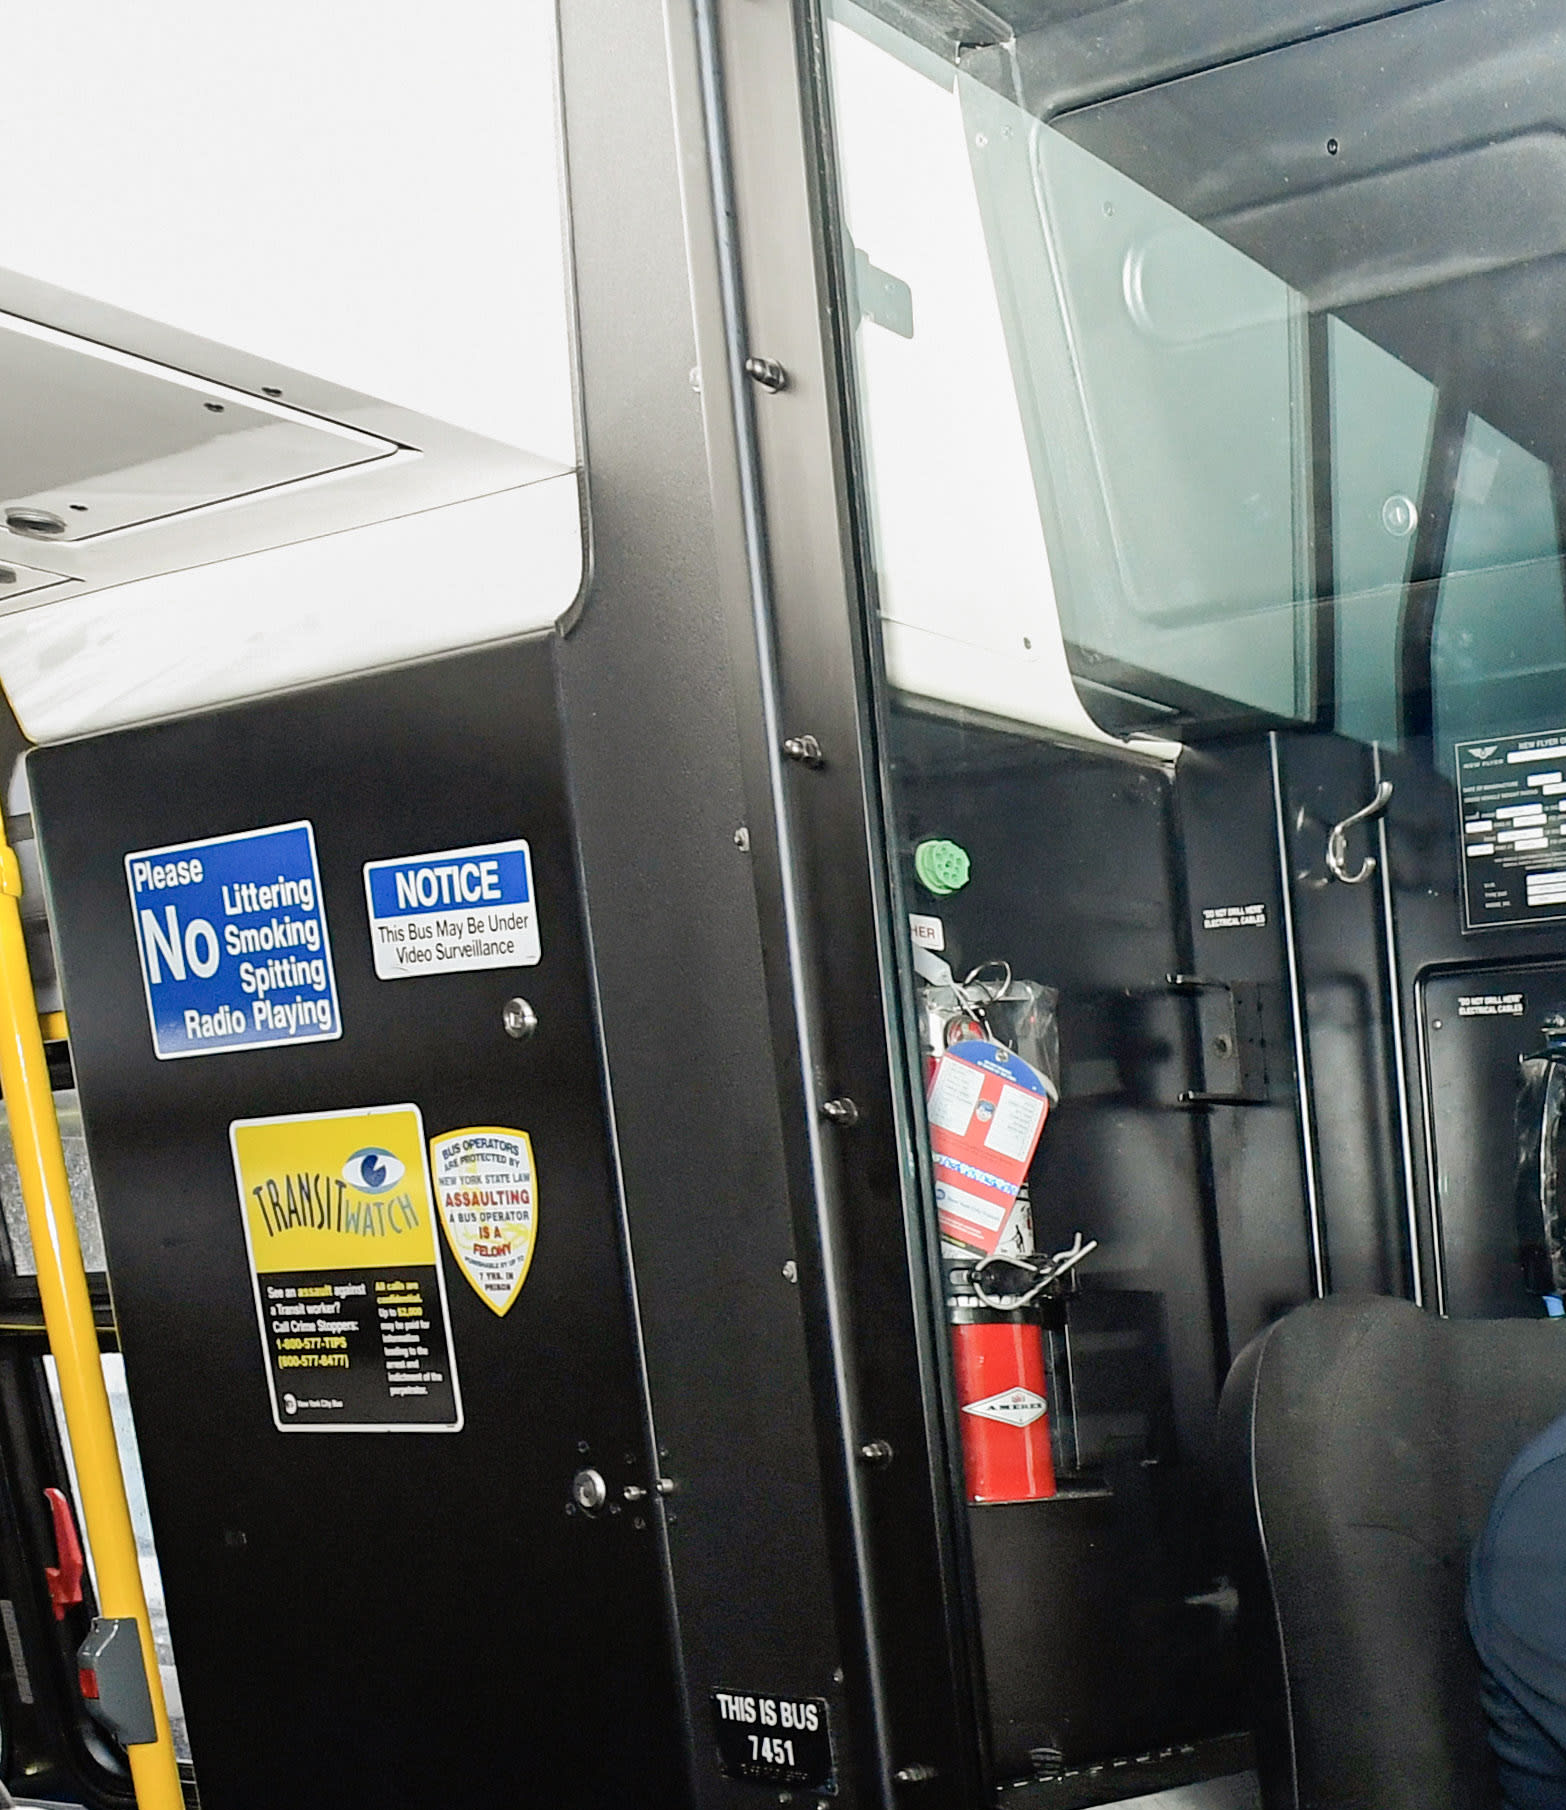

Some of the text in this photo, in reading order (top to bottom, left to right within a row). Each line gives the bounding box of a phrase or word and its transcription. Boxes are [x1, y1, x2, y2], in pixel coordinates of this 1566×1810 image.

[133, 858, 203, 892] Please
[395, 861, 502, 909] NOTICE
[222, 876, 314, 916] Littering
[140, 905, 220, 984] No
[224, 915, 320, 956] Smoking
[378, 913, 529, 944] This Bus May Be Under
[396, 939, 515, 965] Video Surveillance
[239, 955, 326, 999] Spitting
[184, 995, 332, 1039] Radio Playing
[442, 1138, 520, 1160] BUS OPERATORS
[439, 1173, 530, 1186] NEW YORK STATE LAW
[445, 1189, 530, 1207] ASSAULTING
[449, 1210, 530, 1223] A BUS OPERATOR
[478, 1226, 502, 1239] IS A
[473, 1241, 512, 1257] FELONY
[716, 1693, 819, 1732] THIS IS BUS
[747, 1734, 795, 1766] 7451
